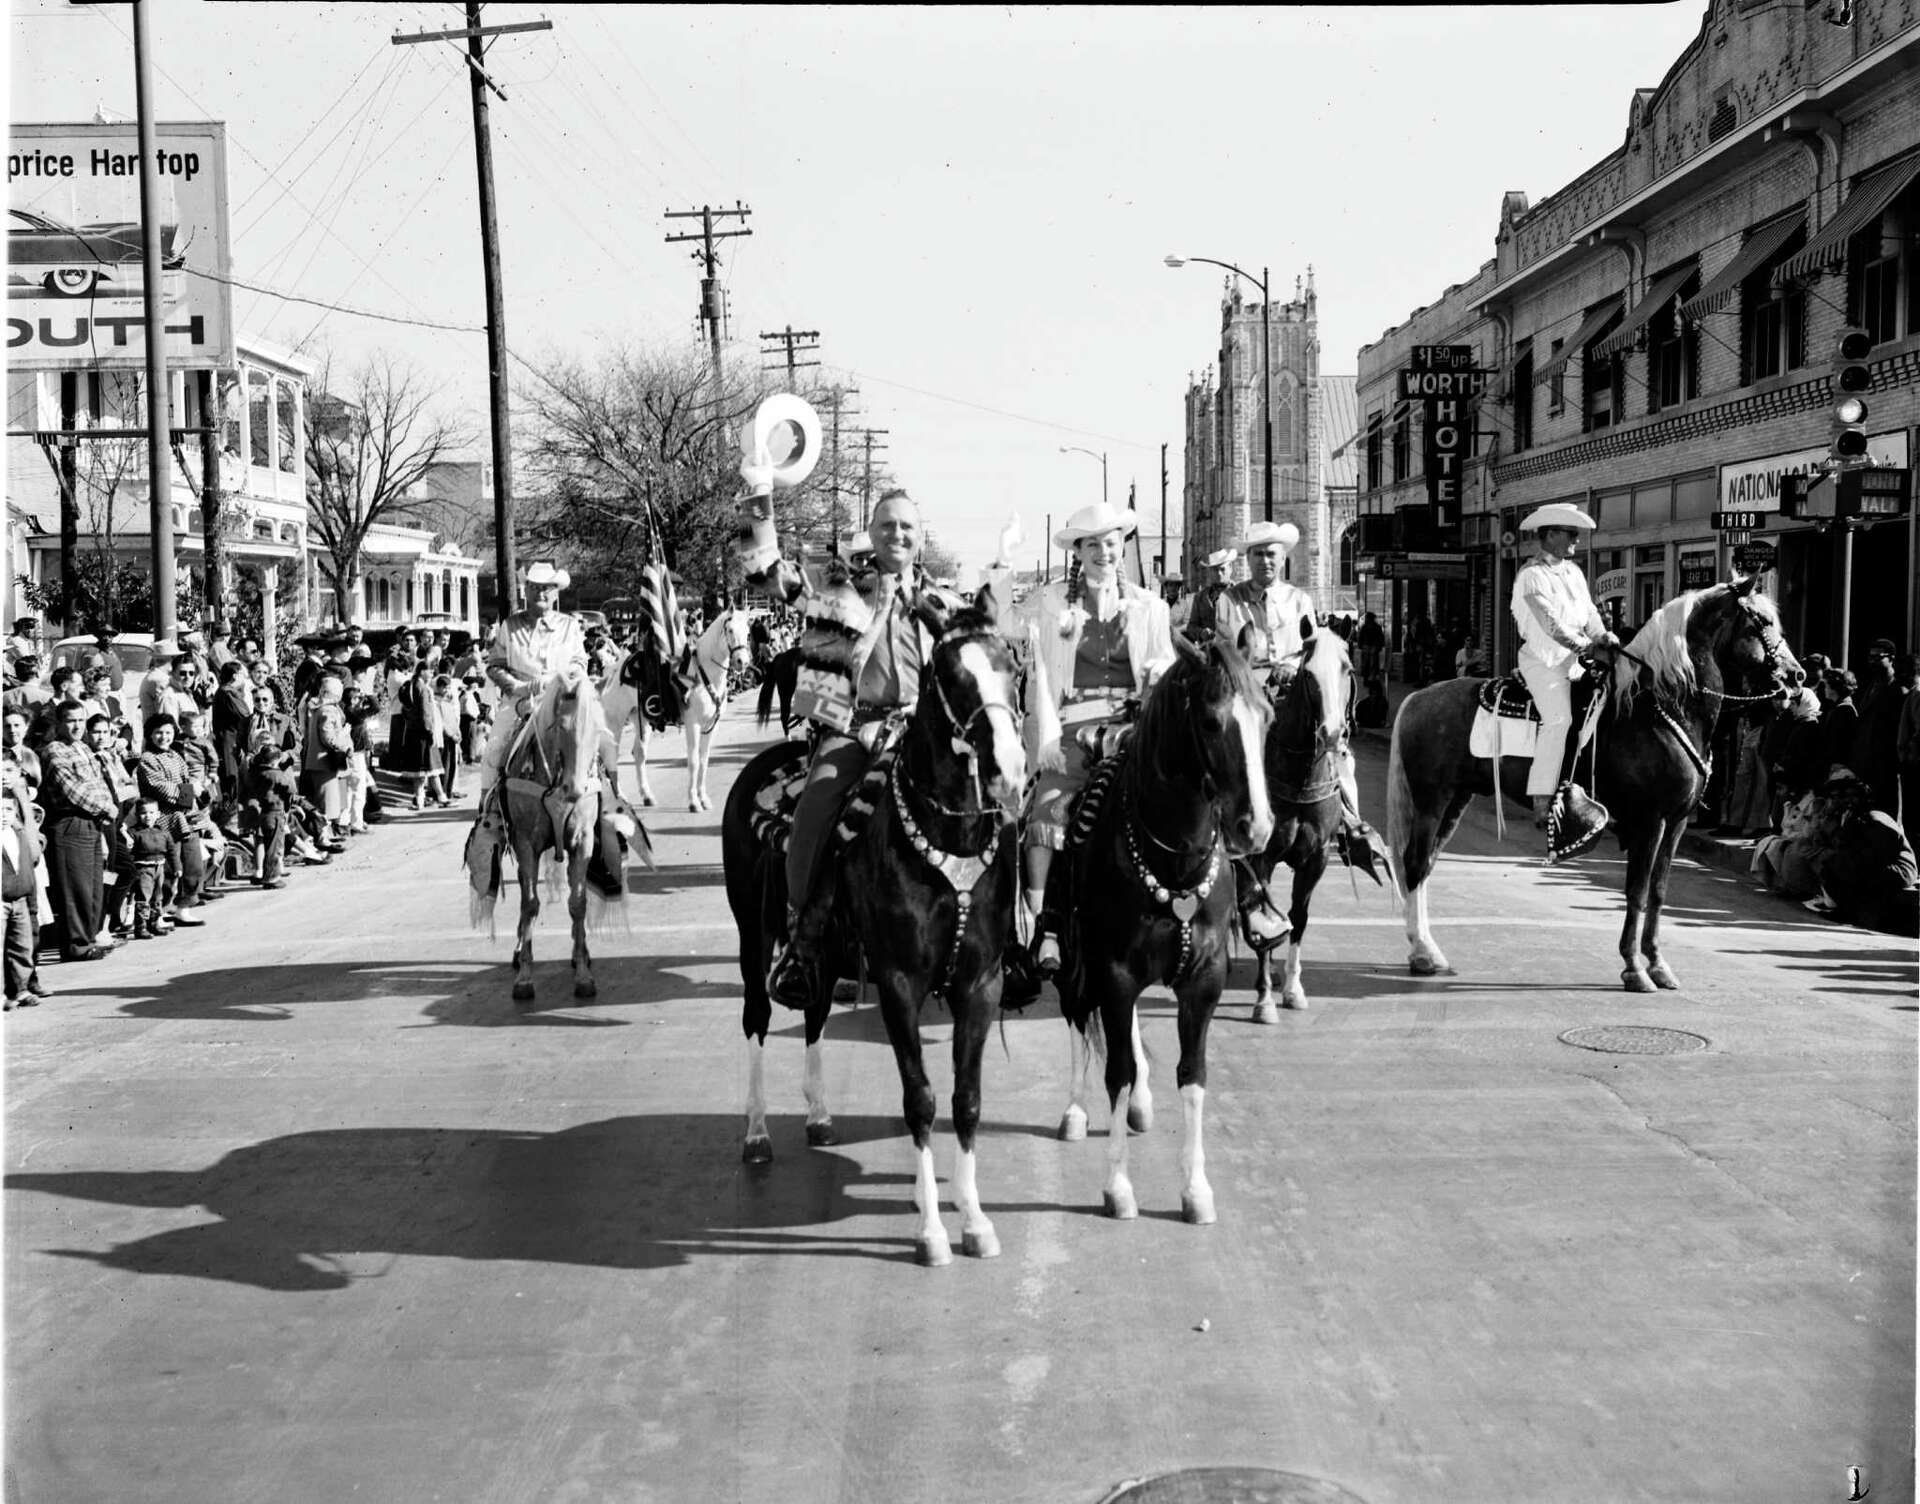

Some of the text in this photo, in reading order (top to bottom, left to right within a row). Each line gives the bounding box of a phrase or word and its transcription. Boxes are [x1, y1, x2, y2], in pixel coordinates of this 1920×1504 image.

[8, 149, 200, 183] price Hartop
[1451, 354, 1469, 369] UP
[1405, 372, 1485, 395] WORTH
[1435, 400, 1459, 528] HOTEL
[1720, 513, 1756, 527] THIRD
